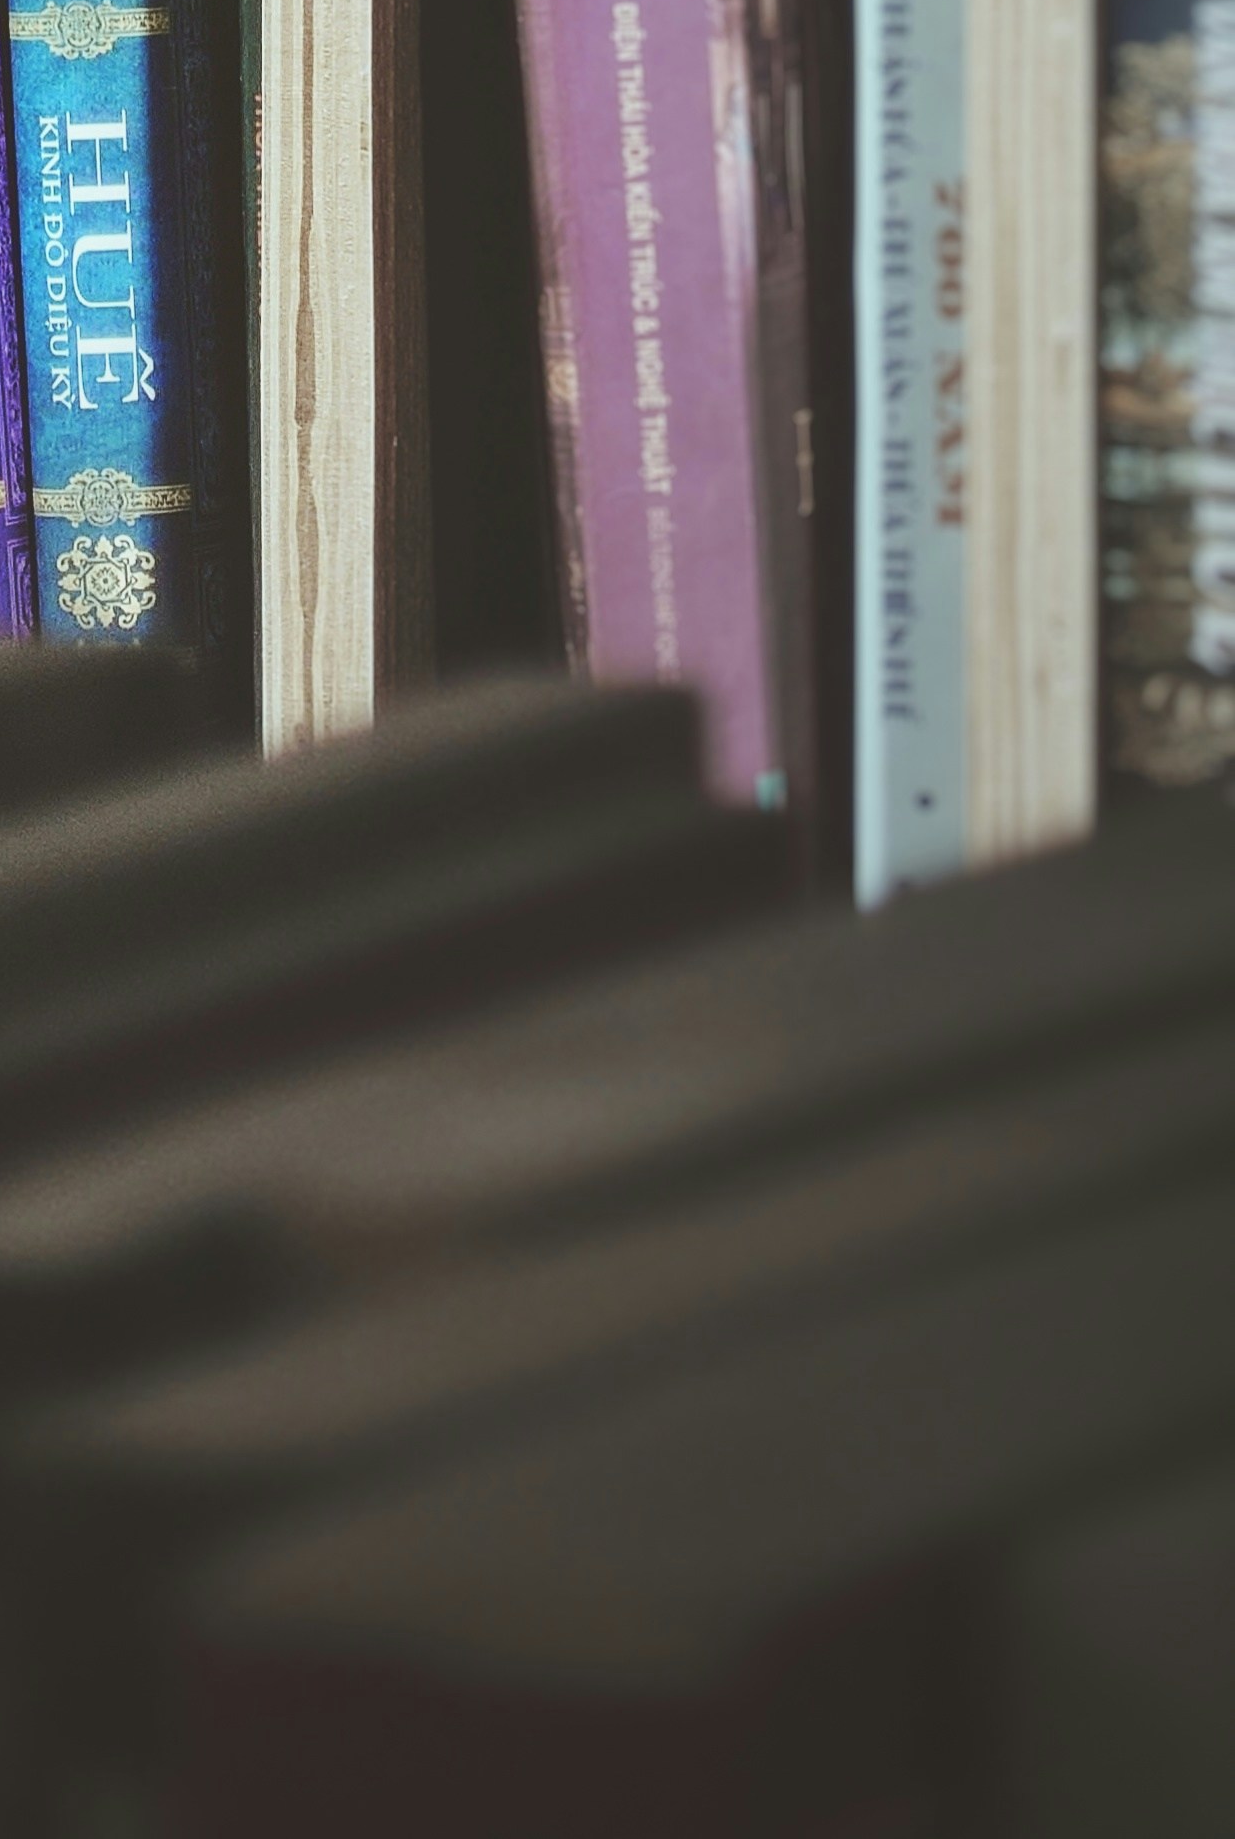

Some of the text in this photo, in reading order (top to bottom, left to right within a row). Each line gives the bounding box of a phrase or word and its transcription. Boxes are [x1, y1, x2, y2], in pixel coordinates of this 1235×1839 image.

[39, 115, 75, 410] KINH ĐÔ DIỆU KỲ
[66, 108, 155, 409] HUẾ
[634, 316, 658, 334] &
